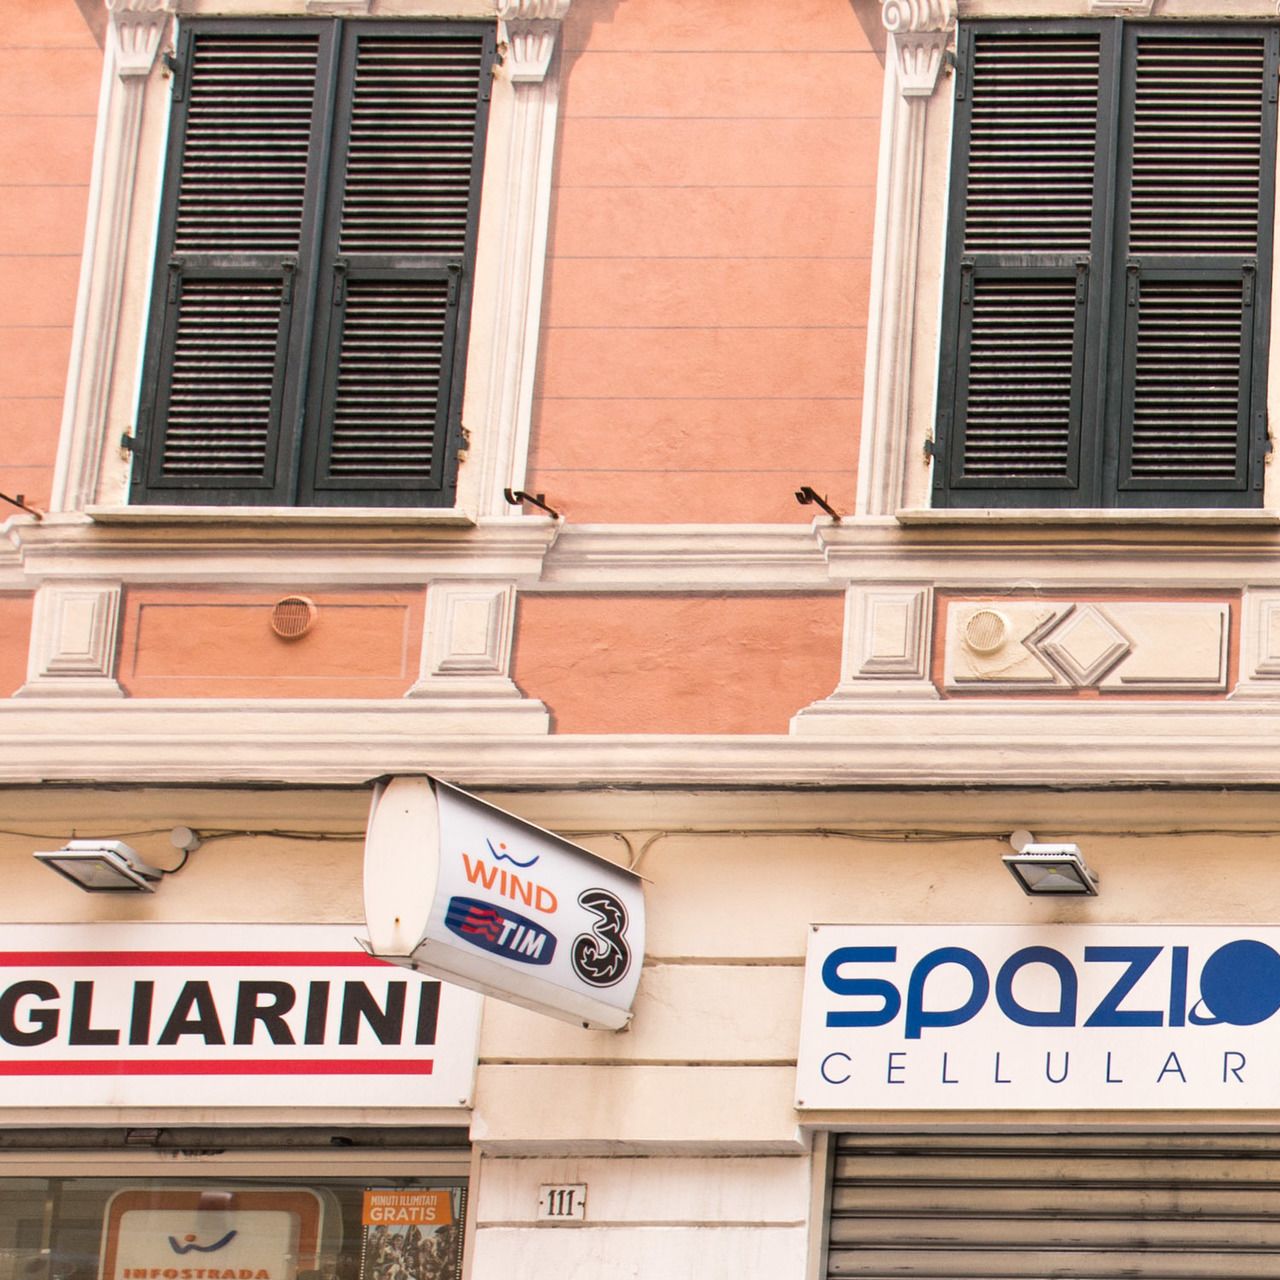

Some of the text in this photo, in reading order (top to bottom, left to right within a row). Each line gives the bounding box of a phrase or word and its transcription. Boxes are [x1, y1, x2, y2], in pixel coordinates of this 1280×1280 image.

[462, 852, 558, 914] WIND
[497, 918, 547, 959] TIM
[0, 979, 441, 1046] GLIARINI
[370, 1195, 437, 1206] MINUTI ILLIMITATI
[370, 1207, 436, 1221] GRATIS
[547, 1189, 576, 1216] 111
[123, 1267, 271, 1280] INFOSTRADA
